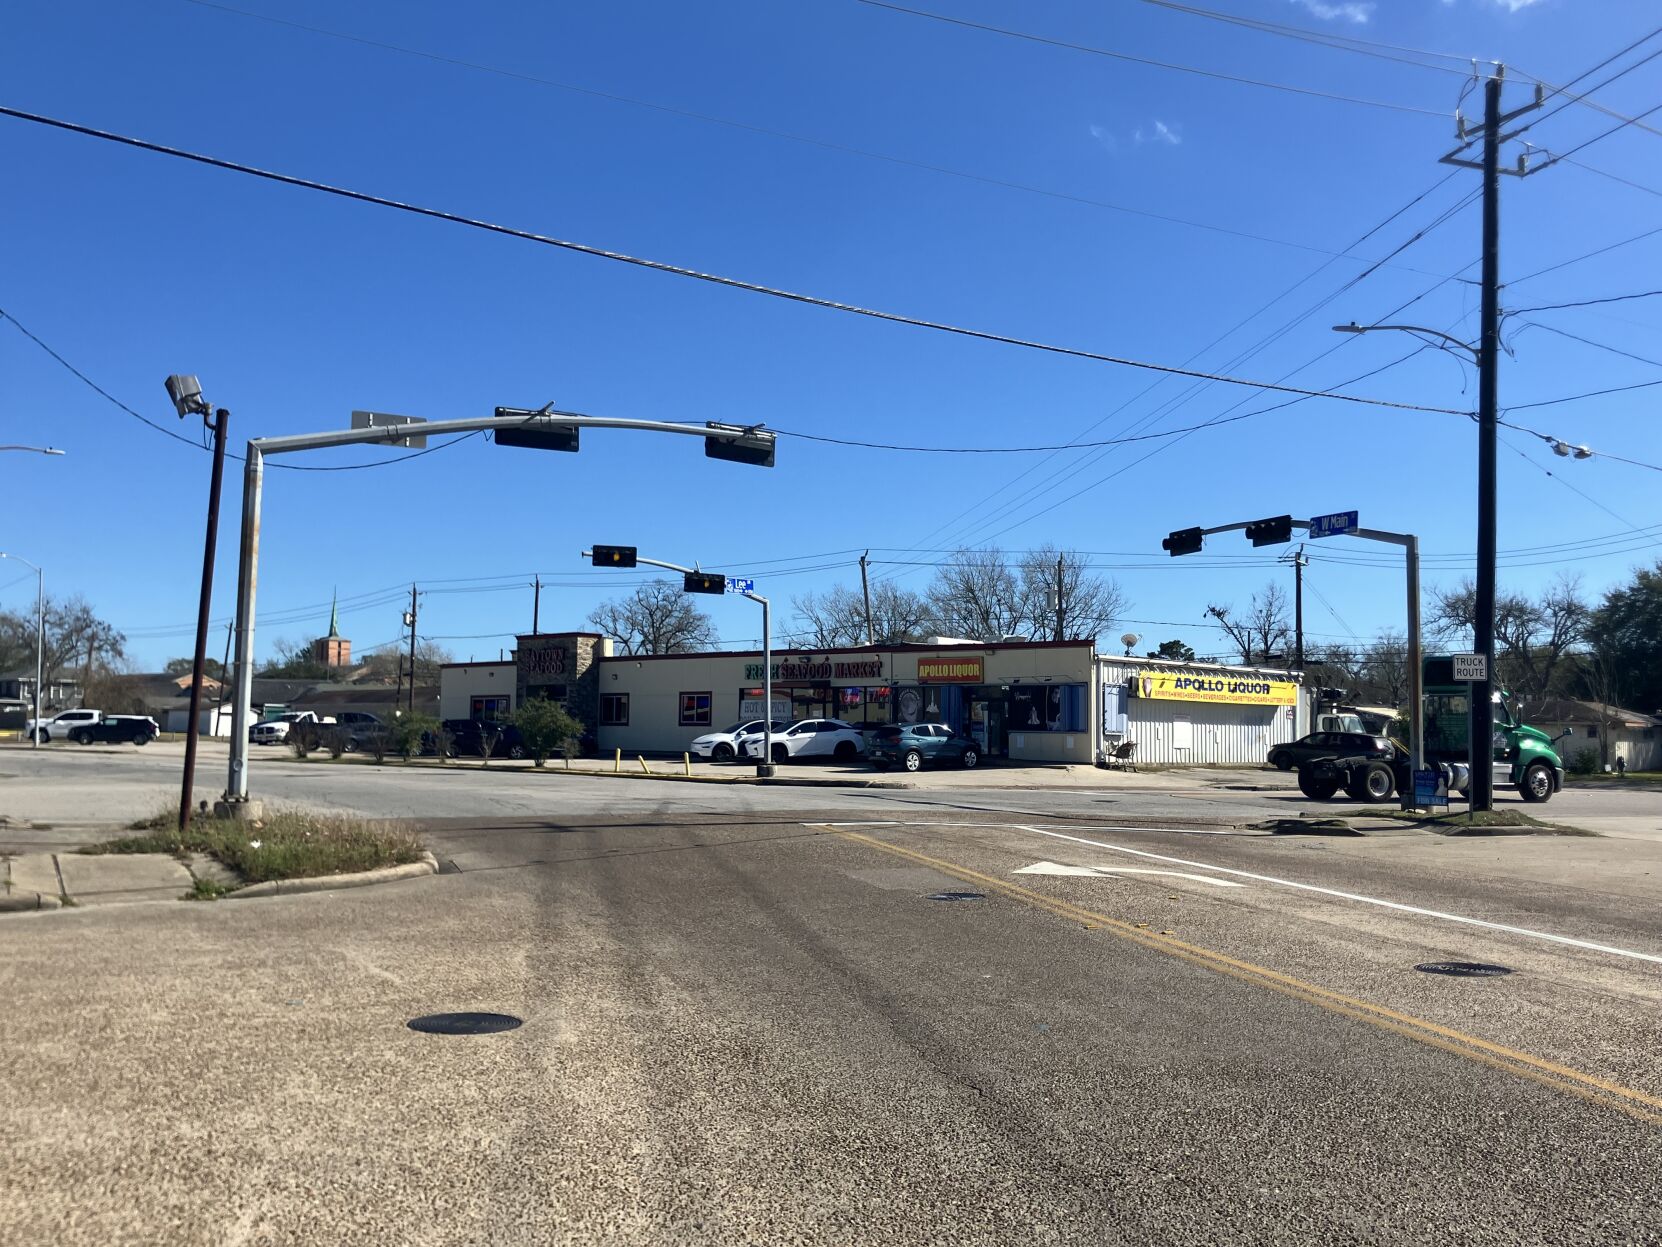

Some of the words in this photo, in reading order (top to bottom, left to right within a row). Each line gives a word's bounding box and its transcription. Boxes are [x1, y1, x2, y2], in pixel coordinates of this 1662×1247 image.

[1321, 517, 1330, 530] W
[1330, 513, 1348, 528] Main
[735, 579, 746, 589] Lee
[524, 662, 563, 674] SEAFOOD
[1455, 657, 1484, 667] TRUCK
[744, 664, 780, 680] FREH
[780, 663, 832, 679] SEAFOOD
[834, 661, 882, 678] MARKET
[919, 664, 949, 677] APOLLO
[949, 663, 980, 678] LIQUOR
[1456, 668, 1485, 677] ROUTE
[1174, 677, 1224, 692] APOLLO
[1227, 681, 1271, 695] LIQUOR
[744, 701, 758, 712] HOT
